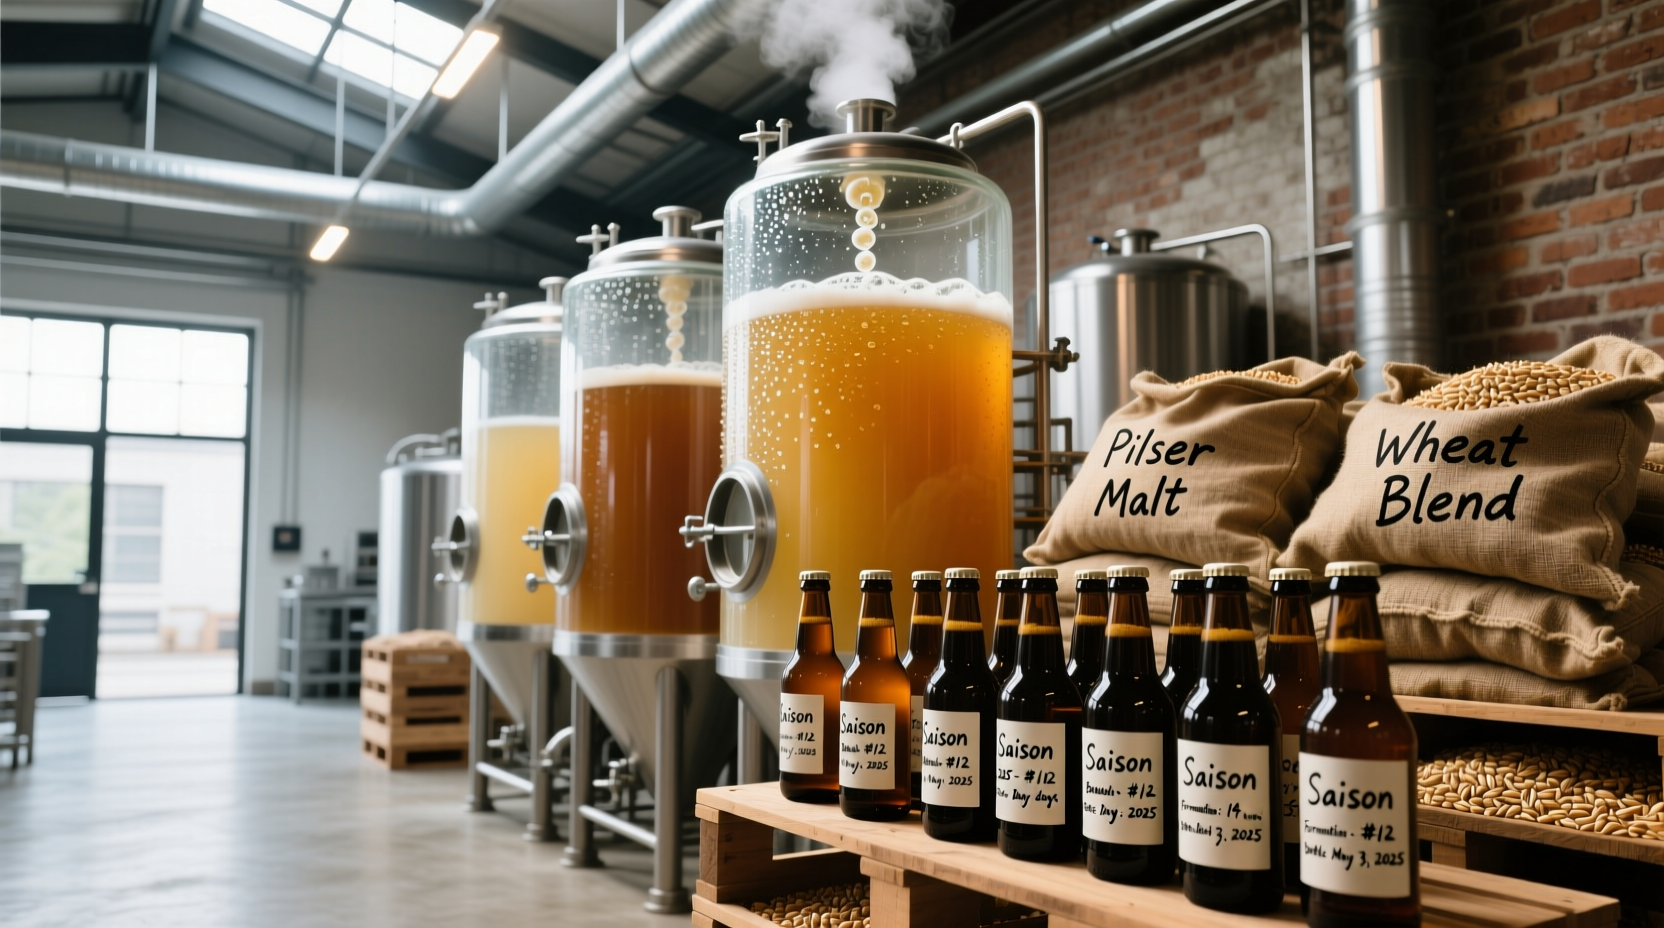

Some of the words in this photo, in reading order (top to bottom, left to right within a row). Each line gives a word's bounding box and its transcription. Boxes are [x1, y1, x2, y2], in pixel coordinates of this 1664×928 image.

[1103, 427, 1215, 469] Pilser
[1375, 420, 1529, 469] Wheat
[1094, 474, 1188, 519] Malt
[1375, 473, 1524, 527] Blend
[841, 713, 886, 735] Saison
[923, 721, 968, 746] Saison
[998, 732, 1054, 760] Saison
[1086, 743, 1152, 773] Saison
[945, 756, 970, 769] #12
[1183, 755, 1257, 790] Saison
[948, 776, 973, 786] 2025
[1127, 782, 1157, 800] #12
[1308, 772, 1393, 810] Saison
[1127, 806, 1158, 819] 2025
[1227, 802, 1242, 819] 14
[1231, 828, 1262, 842] 2025
[1360, 822, 1396, 843] #12
[1332, 847, 1354, 871] May
[1374, 852, 1405, 866] 2025
